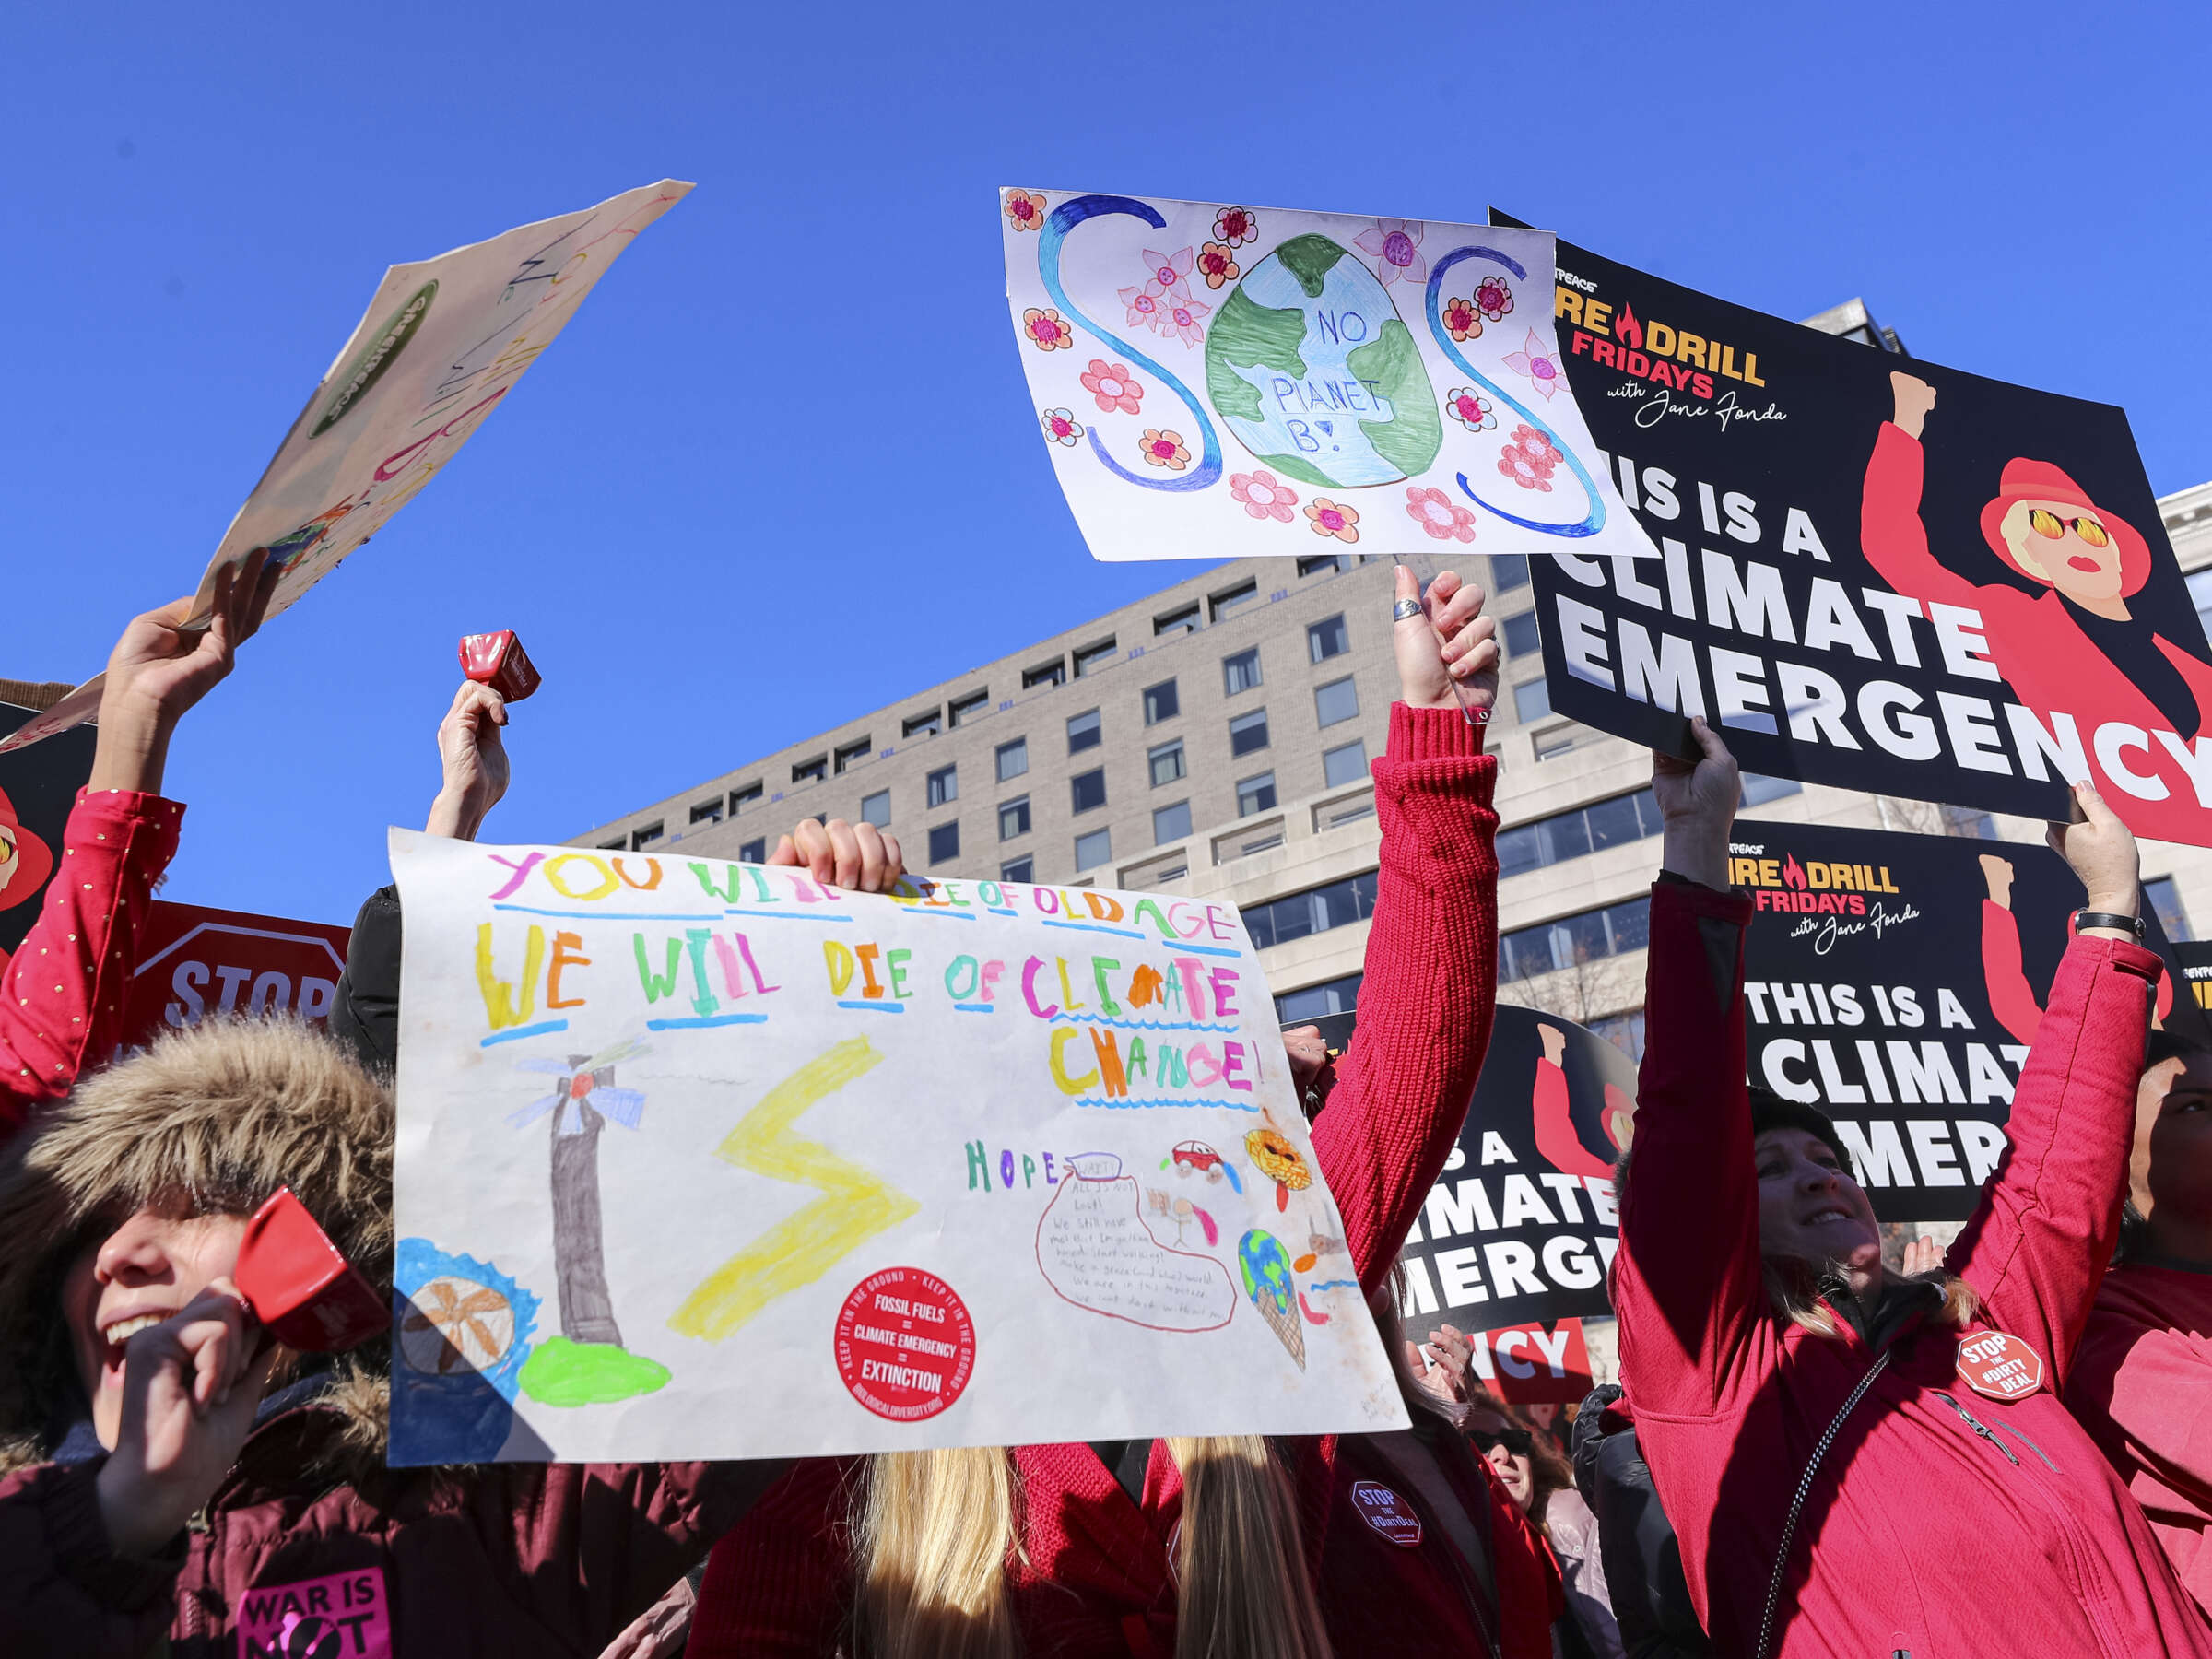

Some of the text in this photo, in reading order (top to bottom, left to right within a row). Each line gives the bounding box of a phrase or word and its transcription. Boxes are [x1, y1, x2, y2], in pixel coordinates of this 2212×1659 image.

[1318, 310, 1367, 345] NO
[1555, 286, 1766, 388] RE DRILL
[1571, 330, 1713, 399] FRIDAYS
[1607, 379, 1787, 432] with Jane Fonda
[1599, 448, 1831, 563] IS IS A
[488, 853, 663, 900] YOU
[978, 880, 1018, 909] OF
[1034, 888, 1124, 923] OLD
[1135, 899, 1236, 940] AGE
[1728, 857, 1899, 894] IRE DRILL
[1755, 890, 1866, 915] FRIDAYS
[1791, 902, 1919, 955] with Jane Fonda
[164, 960, 336, 1029] STOP
[475, 923, 1240, 1030] WE WILL DIE OF CLIMATE
[1744, 982, 1975, 1029] THIS IS A
[1761, 1038, 2031, 1104] CLIMAT
[965, 1140, 1058, 1193] HOPE
[1481, 1131, 1518, 1166] A
[922, 1276, 947, 1297] KEEP
[840, 1340, 853, 1370] KEEP
[866, 1271, 905, 1293] GROUND
[874, 1293, 946, 1324] FOSSIL FUELS
[853, 1324, 957, 1359] CLIMATE EMERGENCY
[1961, 1335, 2007, 1364] STOP
[1989, 1355, 2006, 1366] THE
[861, 1359, 942, 1394] EXTINCTION
[1982, 1358, 2027, 1385] #DIRTY
[1999, 1372, 2035, 1393] DEAL
[1358, 1489, 1394, 1505] STOP
[245, 1576, 374, 1626] WAR IS
